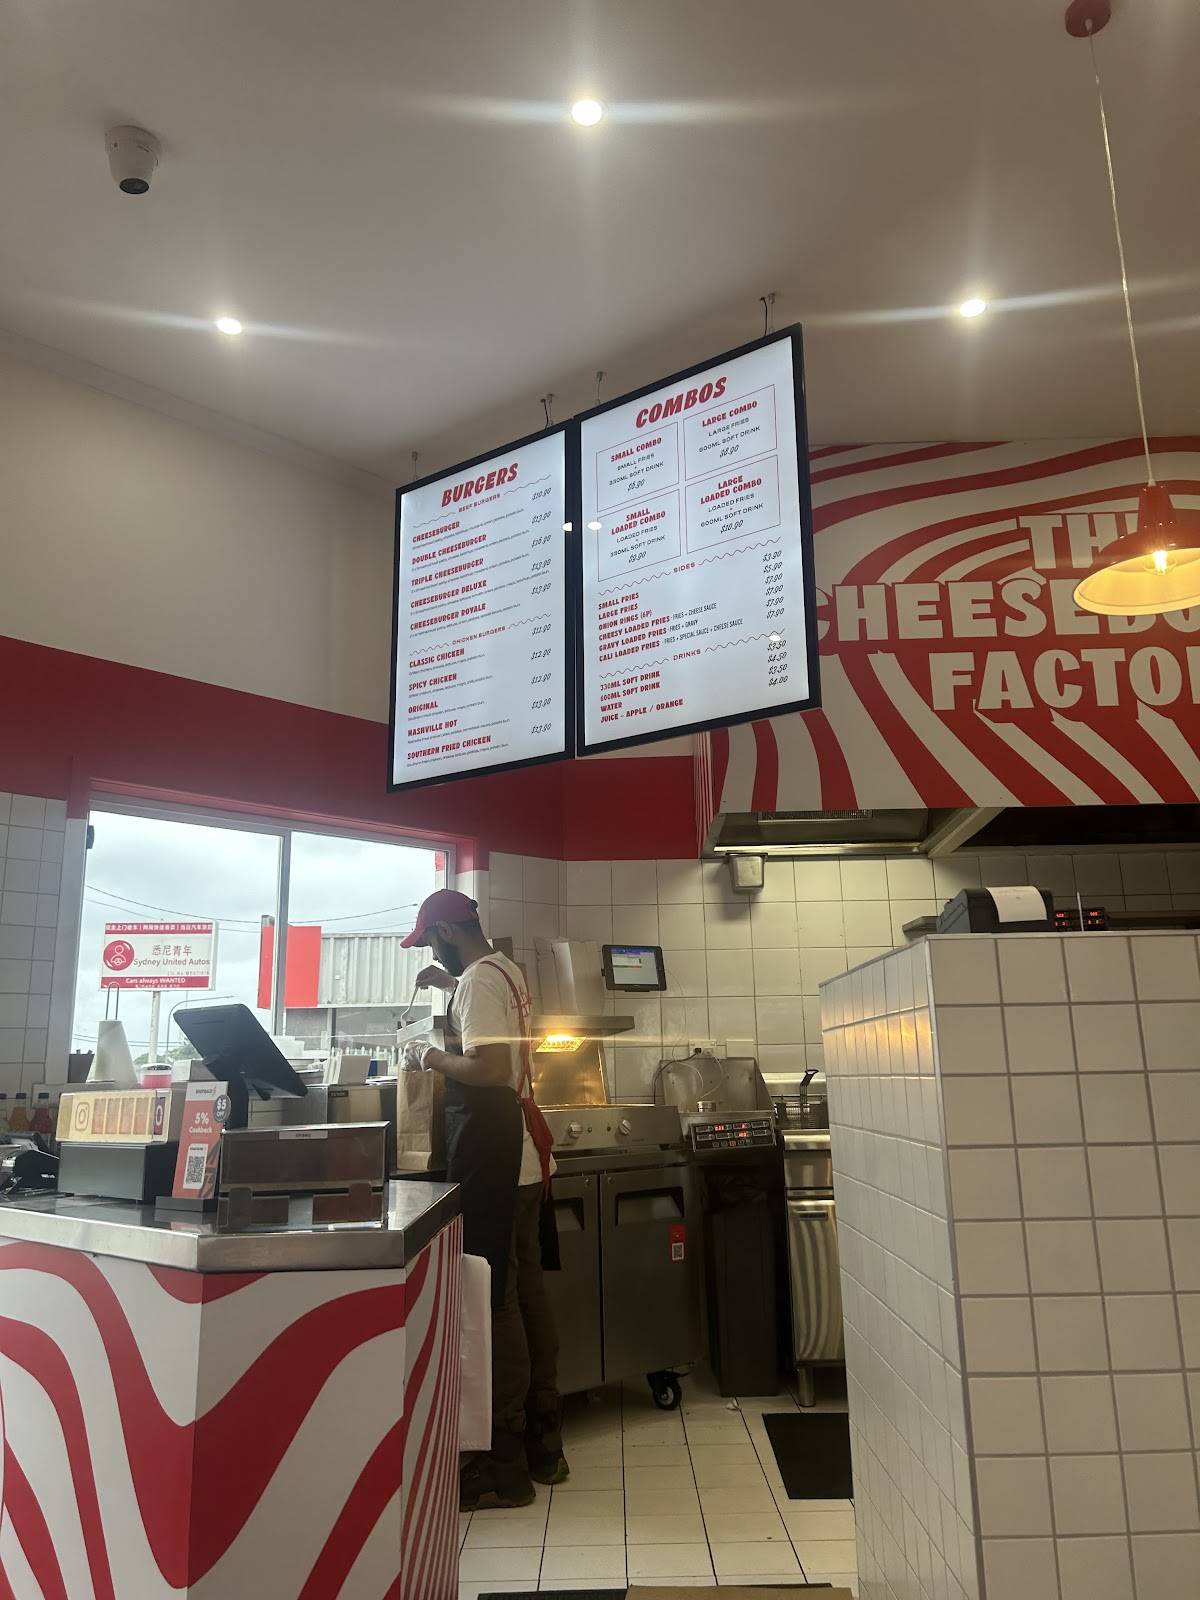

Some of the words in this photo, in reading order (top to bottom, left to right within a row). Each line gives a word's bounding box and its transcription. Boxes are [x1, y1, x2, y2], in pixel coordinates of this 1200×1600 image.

[636, 376, 727, 428] COMBOS
[702, 412, 726, 427] LARGE
[729, 401, 757, 417] COMBO
[709, 425, 730, 437] LARGE
[731, 417, 749, 428] FRIES
[611, 448, 634, 462] SMALL
[636, 437, 661, 452] COMBO
[442, 463, 518, 507] BURGERS
[701, 489, 730, 504] LOADED
[733, 478, 762, 493] COMBO
[718, 475, 743, 490] LARGE
[459, 504, 472, 512] BEEF
[474, 493, 500, 507] BURGERS
[708, 500, 735, 512] LOADED
[736, 493, 754, 503] FRIES
[724, 509, 741, 520] SOFT
[743, 503, 763, 513] DRINK
[612, 521, 638, 535] LOADED
[640, 511, 665, 525] COMBO
[626, 508, 650, 522] SMALL
[413, 521, 460, 543] CHEESEBURGER
[617, 531, 640, 543] LOADED
[641, 525, 657, 534] FRIES
[412, 552, 436, 564] DOUBLE
[438, 535, 486, 556] CHEESEBURGER
[1019, 514, 1138, 569] TH
[763, 550, 782, 562] $3.90
[411, 574, 432, 586] TRIPLE
[435, 558, 483, 579] CHEESEBURGER
[673, 562, 695, 573] SIDES
[763, 562, 782, 574] $5.90
[765, 573, 783, 584] $7.90
[411, 589, 459, 608] CHEESEBURGER
[461, 580, 486, 593] DELUXE
[766, 585, 783, 596] $7.90
[598, 599, 619, 610] SMALL
[621, 592, 639, 603] FRIES
[766, 596, 784, 607] $7.90
[410, 611, 459, 630] CHEESEBURGER
[461, 603, 486, 616] ROYALE
[599, 609, 618, 620] LARGE
[620, 603, 638, 614] FRIES
[767, 608, 784, 619] $7.90
[599, 620, 618, 631] ONION
[620, 614, 638, 624] RINGS
[599, 629, 622, 641] CHEESY
[625, 622, 649, 634] LOADED
[651, 616, 670, 626] FRIES
[452, 634, 477, 645] CHICKEN
[479, 626, 505, 638] BURGERS
[599, 640, 619, 651] GRAVY
[621, 633, 646, 645] LOADED
[648, 628, 667, 638] FRIES
[599, 653, 613, 662] CALI
[615, 646, 639, 658] LOADED
[641, 640, 660, 651] FRIES
[767, 640, 786, 651] $3.50
[409, 656, 434, 668] CLASSIC
[437, 648, 464, 661] CHICKEN
[673, 649, 701, 661] DRINKS
[768, 652, 787, 663] $4.50
[768, 664, 787, 675] $3.50
[929, 647, 1200, 710] FACTO
[409, 680, 427, 691] SPICY
[429, 673, 457, 686] CHICKEN
[600, 681, 621, 691] 330ML
[623, 676, 638, 686] SOFT
[640, 671, 660, 681] DRINK
[623, 687, 638, 696] SOFT
[640, 682, 660, 692] DRINK
[769, 675, 788, 687] $4.00
[408, 701, 438, 713] ORIGINAL
[601, 702, 622, 712] WATER
[601, 713, 618, 723] JUICE
[626, 707, 647, 717] APPLE
[656, 699, 683, 711] ORANGE
[408, 723, 443, 736] NASHVILLE
[445, 720, 457, 728] HOT
[408, 747, 439, 760] SOUTHERN
[442, 742, 460, 752] FRIED
[462, 736, 491, 748] CHICKEN
[152, 945, 192, 956] 悉尼青年
[134, 958, 160, 967] Sydney
[162, 958, 186, 966] United
[216, 1098, 226, 1110] $5
[194, 1112, 209, 1124] 5%
[189, 1126, 212, 1134] Cashback
